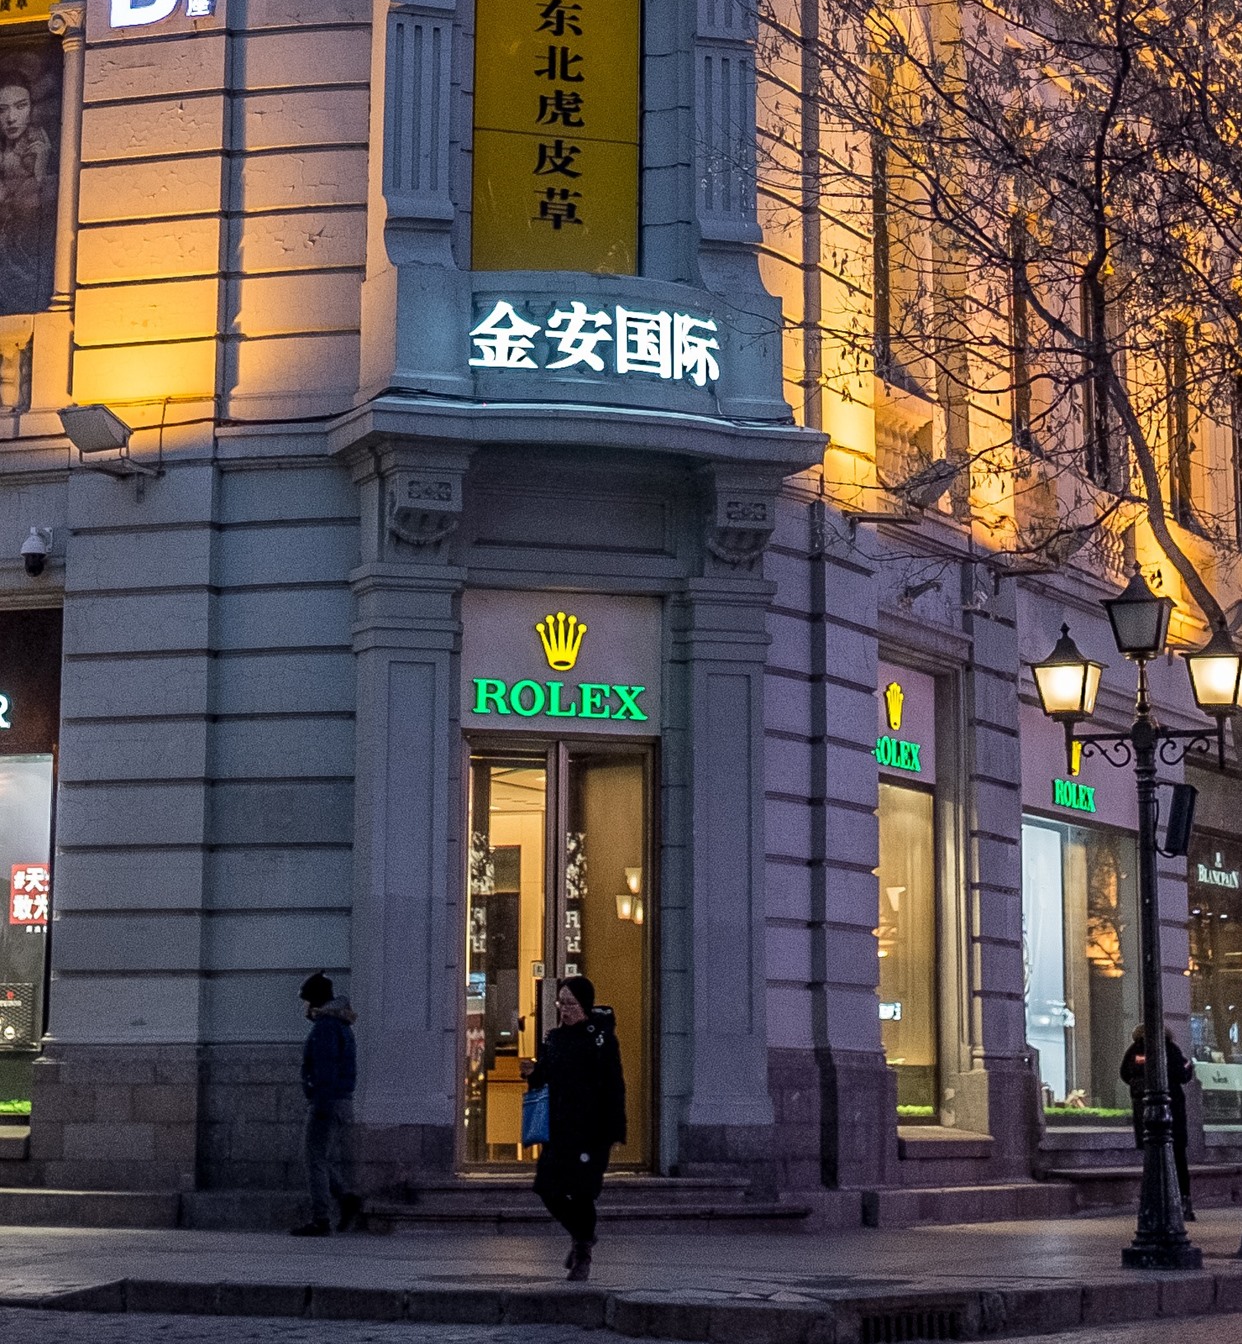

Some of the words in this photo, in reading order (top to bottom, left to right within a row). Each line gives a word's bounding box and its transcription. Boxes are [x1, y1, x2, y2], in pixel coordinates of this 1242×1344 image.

[468, 300, 720, 386] 金安国际
[472, 678, 648, 721] ROLEX
[1054, 778, 1096, 813] ROLEX
